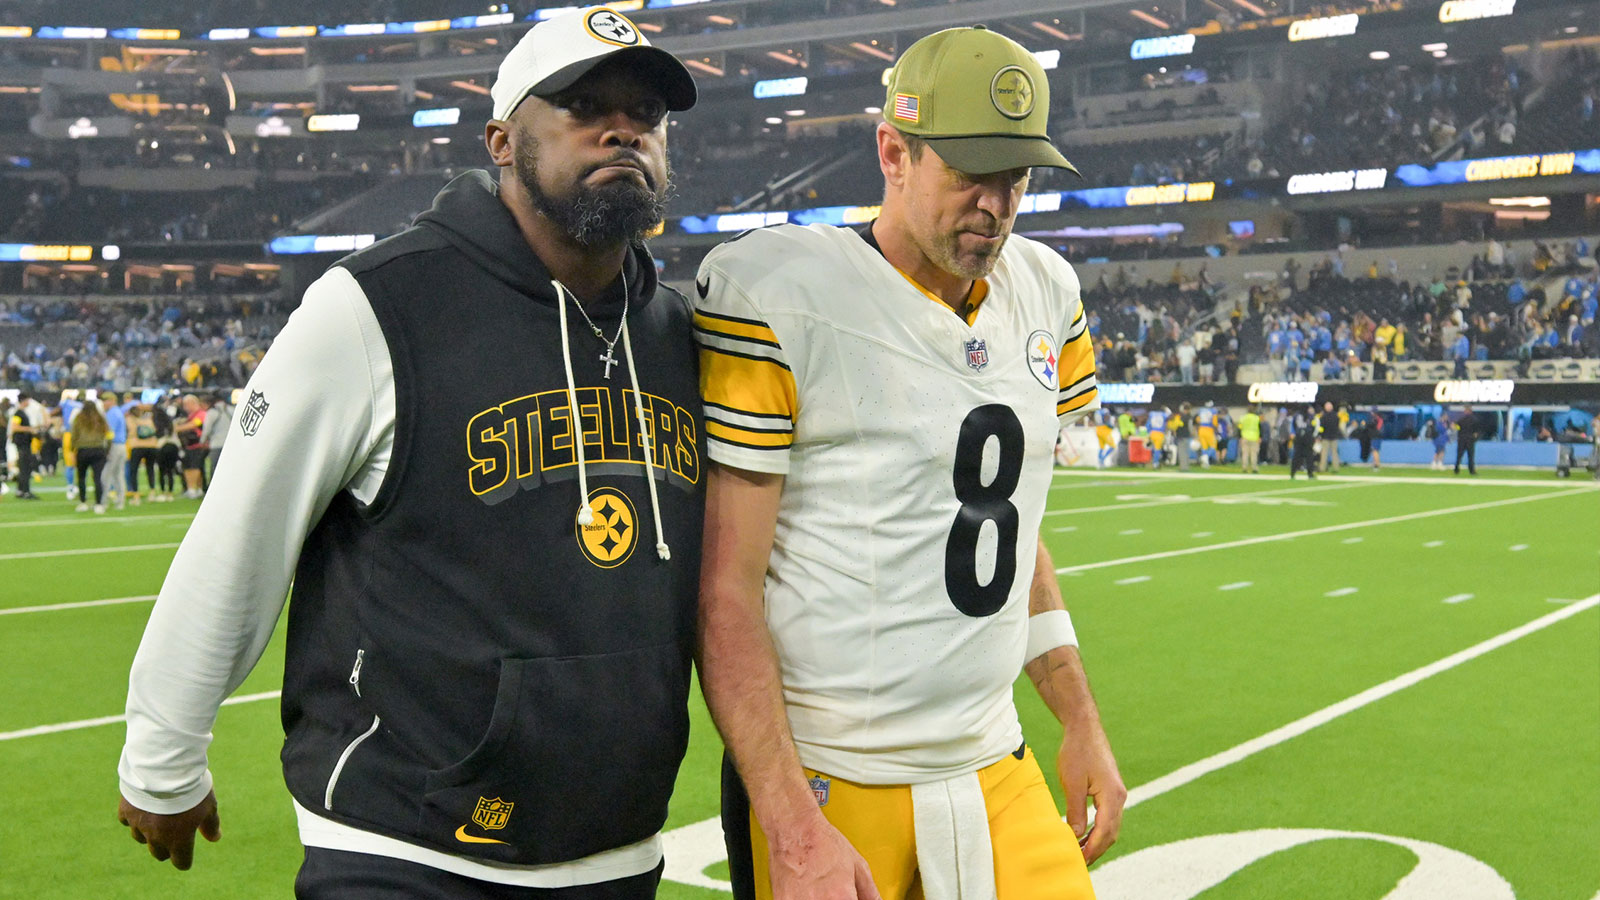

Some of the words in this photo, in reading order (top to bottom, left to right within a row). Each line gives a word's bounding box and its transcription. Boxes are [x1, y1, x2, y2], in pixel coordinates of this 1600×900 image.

[466, 387, 700, 496] STEELERS
[945, 403, 1025, 617] 8
[477, 809, 504, 827] NFL
